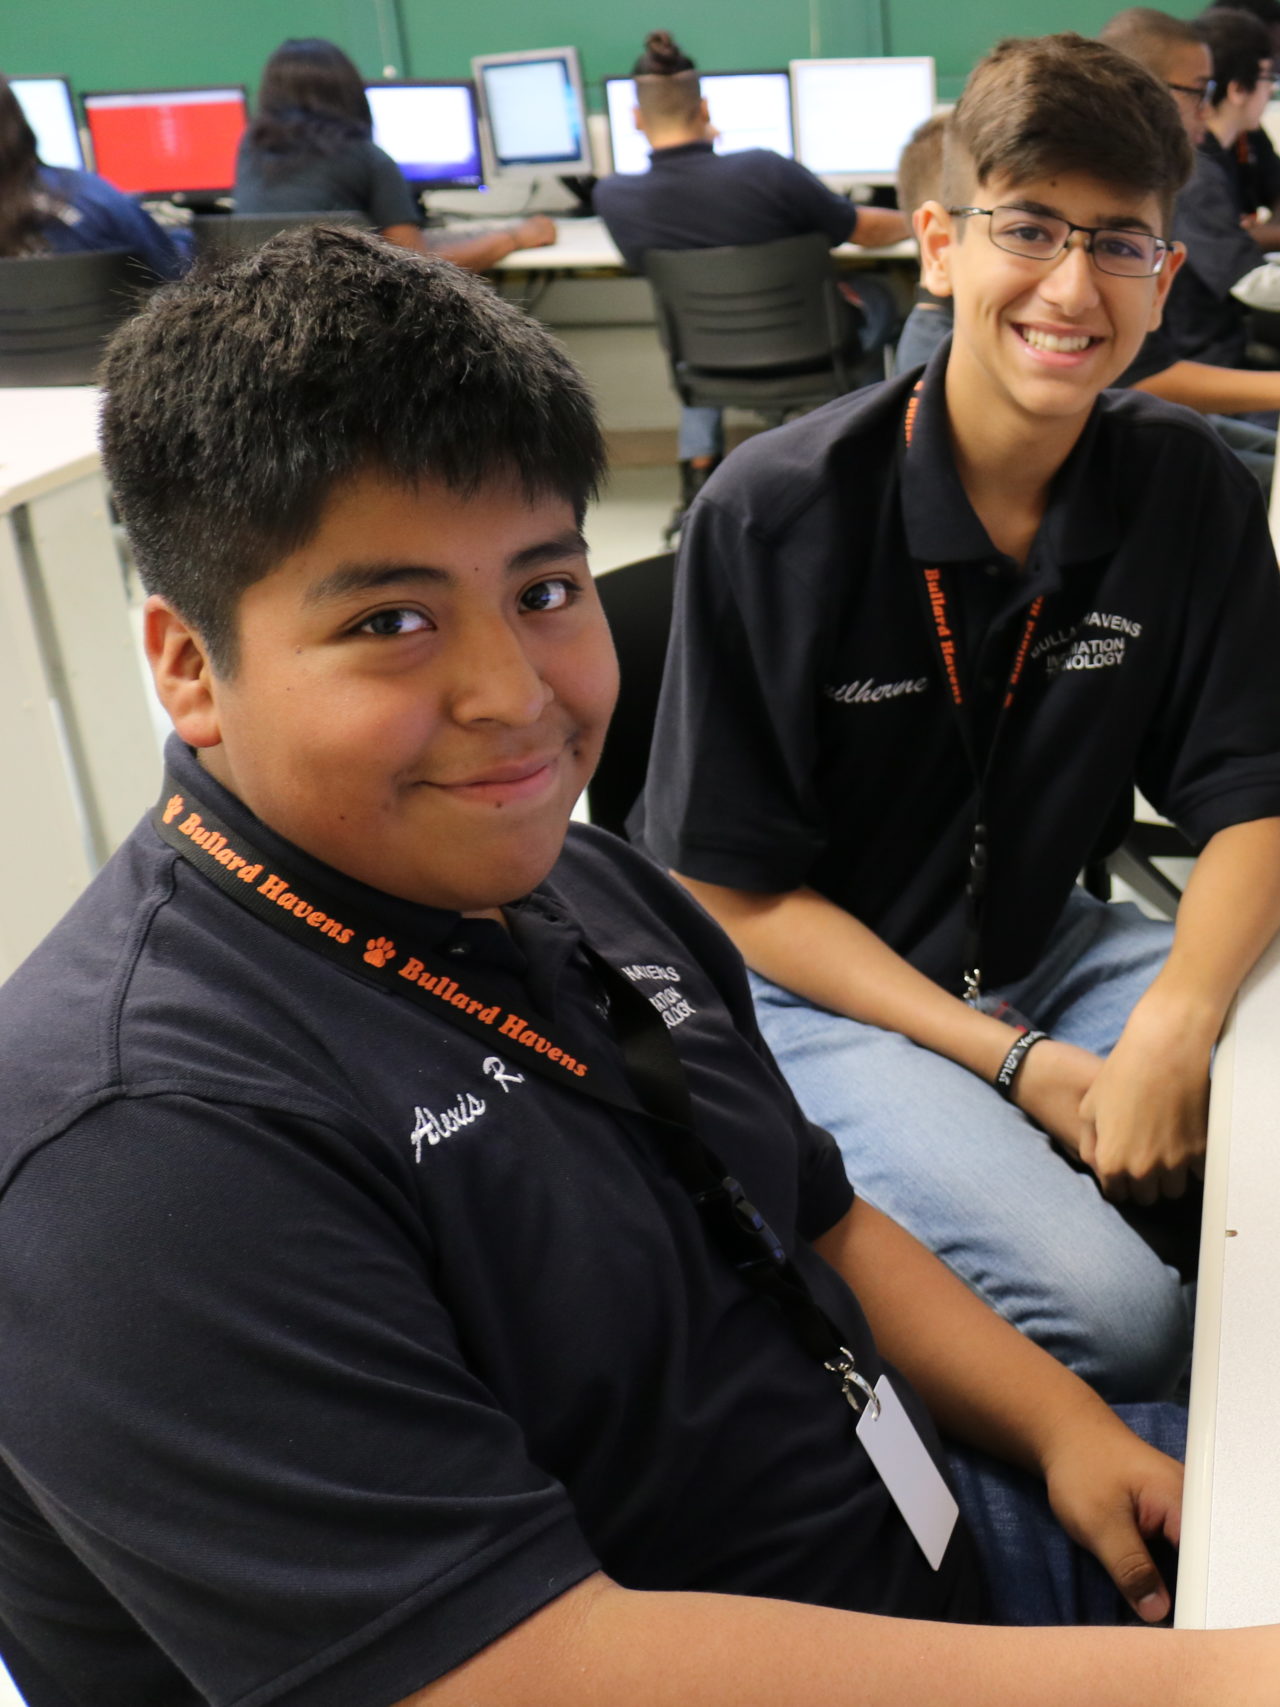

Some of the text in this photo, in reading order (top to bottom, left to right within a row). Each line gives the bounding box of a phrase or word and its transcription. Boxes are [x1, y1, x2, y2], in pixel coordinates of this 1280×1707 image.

[924, 568, 951, 637] Bullard
[177, 812, 355, 945] Bullard Havens
[397, 957, 589, 1078] Bullard Havens
[410, 1055, 524, 1163] Alexis R
